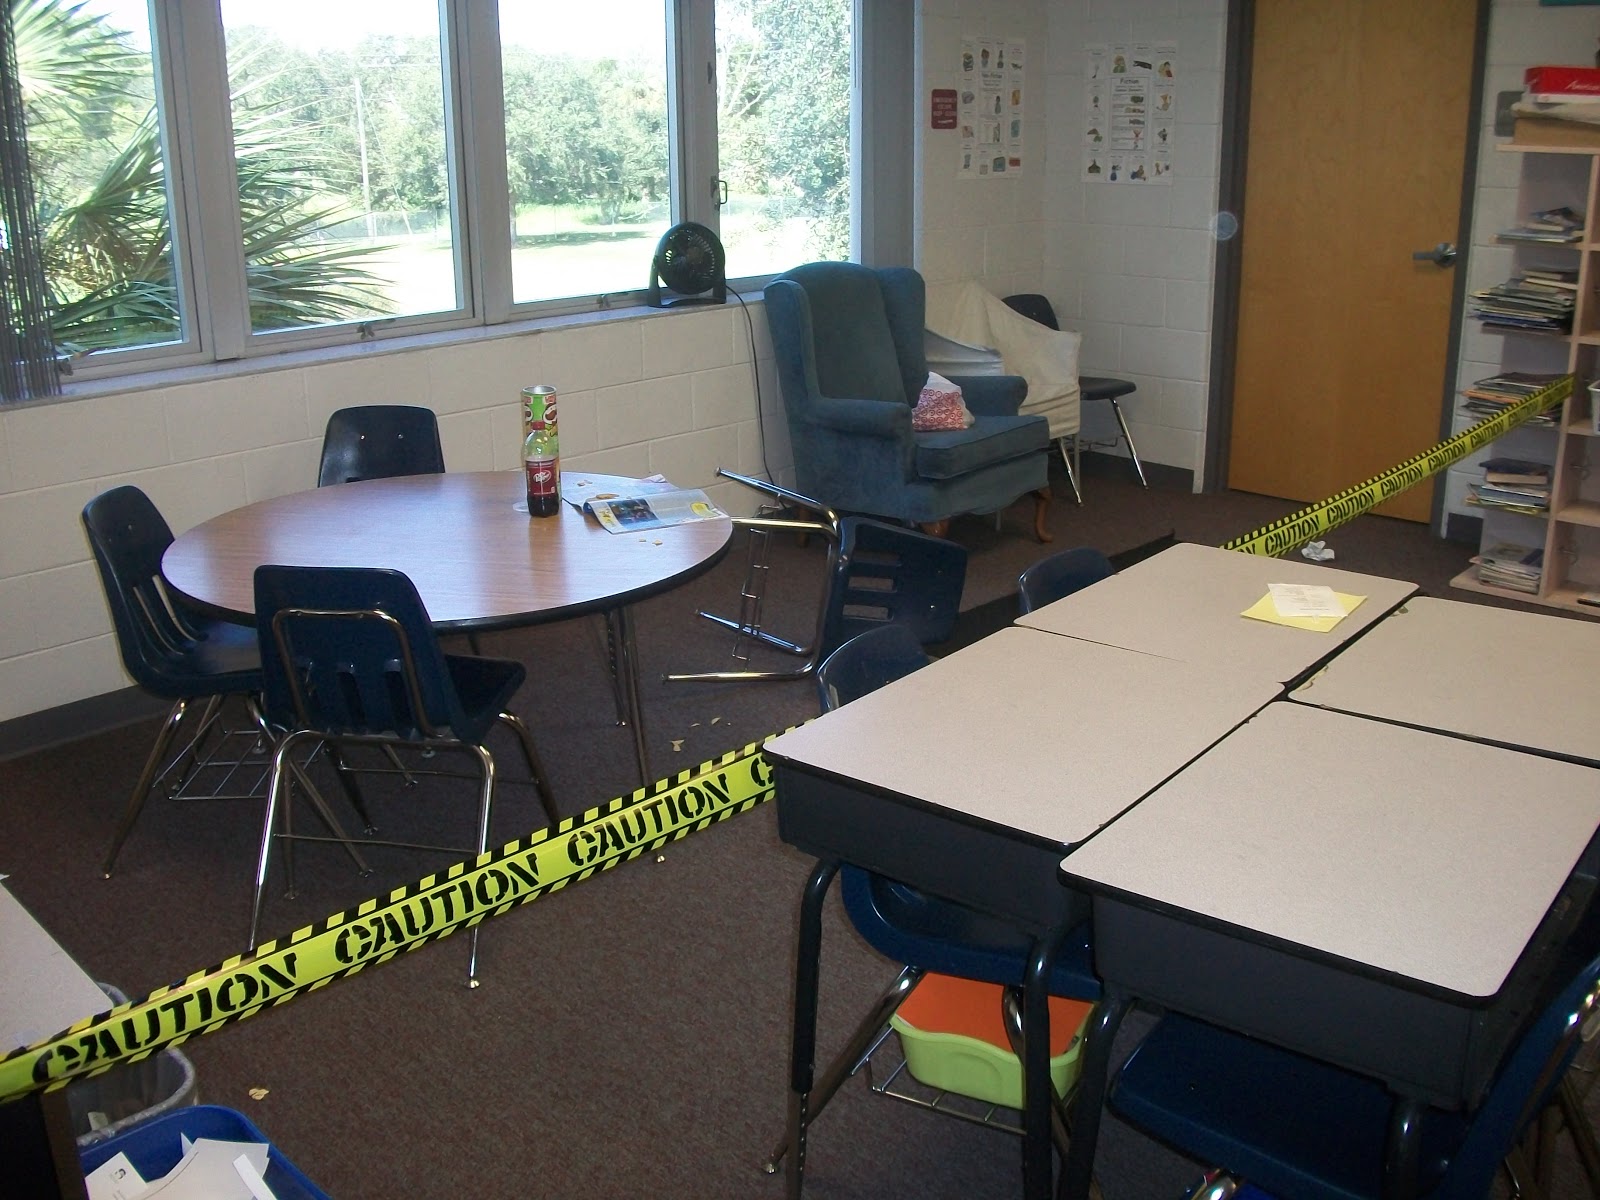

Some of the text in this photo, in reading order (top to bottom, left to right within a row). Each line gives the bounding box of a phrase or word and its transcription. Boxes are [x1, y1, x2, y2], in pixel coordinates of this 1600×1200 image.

[1265, 514, 1319, 555] CAUTION
[1327, 488, 1375, 524] CAUTION
[1380, 464, 1423, 497] CAUTION
[1428, 442, 1466, 472] CAUTION
[1470, 419, 1504, 448] CAUTION
[32, 773, 730, 1084] CAUTION CAUTION CAUTION
